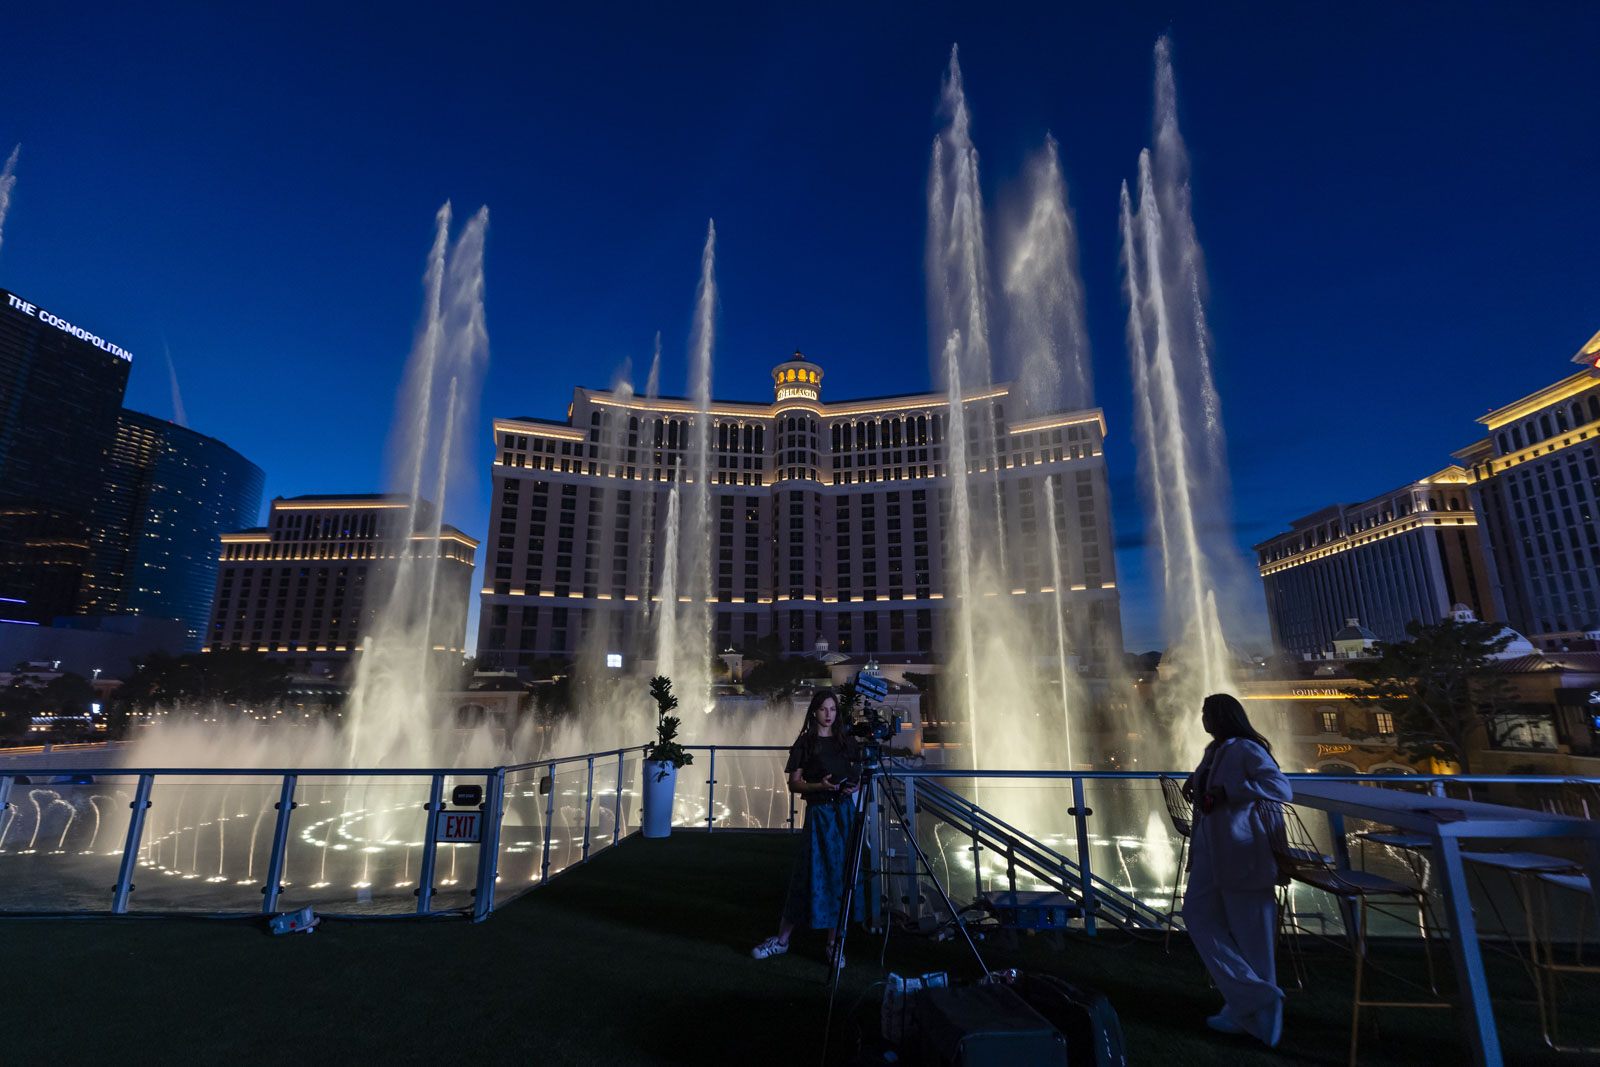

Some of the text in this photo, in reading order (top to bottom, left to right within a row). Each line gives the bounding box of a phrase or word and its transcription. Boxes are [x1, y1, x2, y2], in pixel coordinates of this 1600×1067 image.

[7, 293, 133, 362] THE COSMOPOLITAN
[1292, 688, 1319, 696] LOUIS
[445, 815, 476, 838] EXIT
